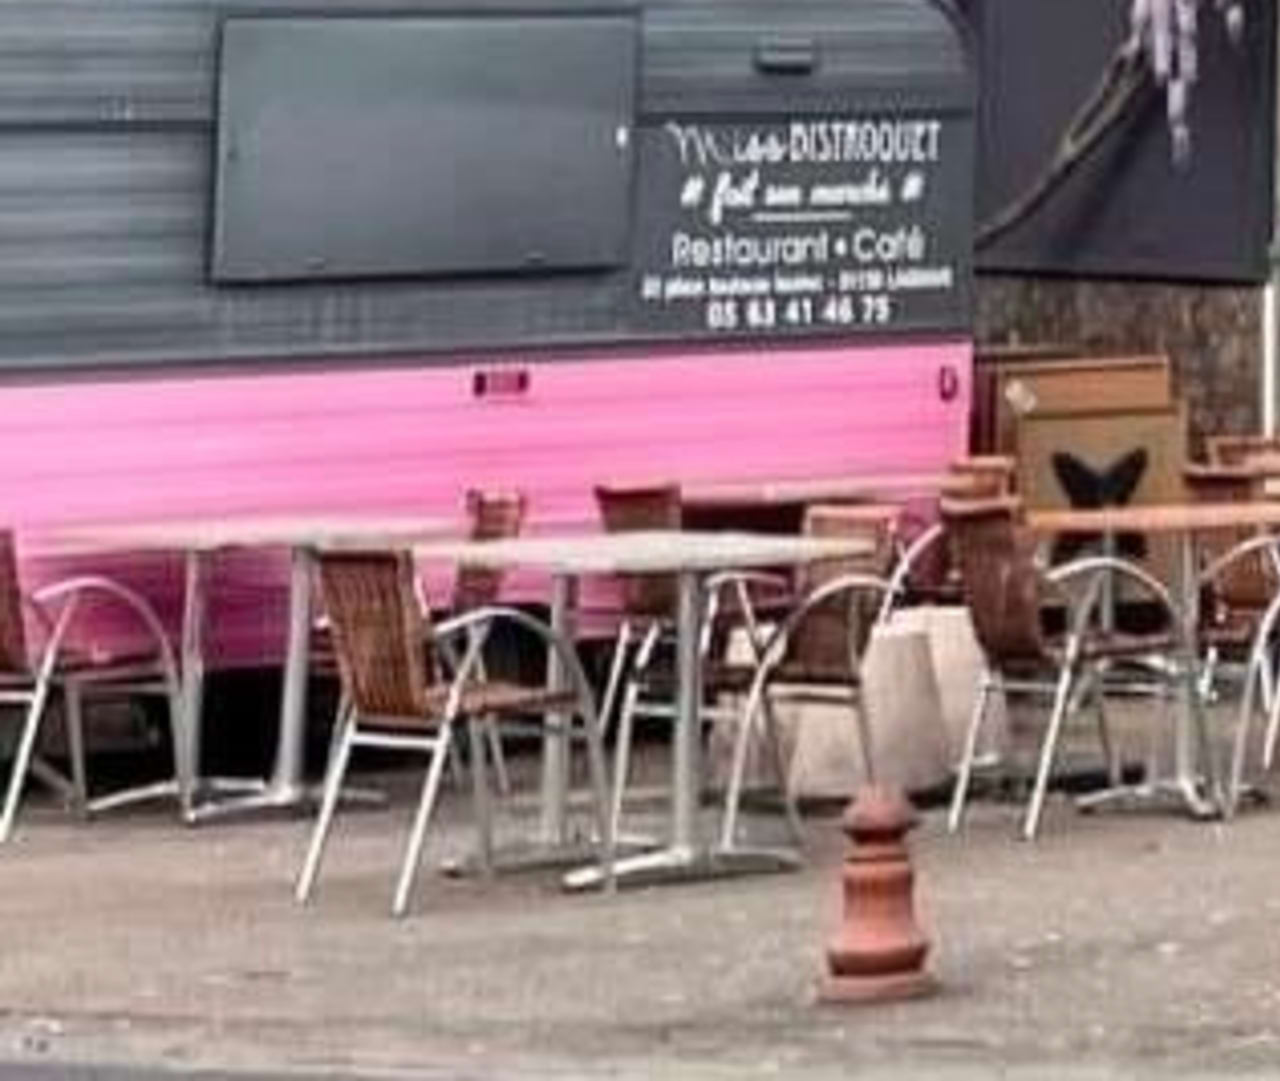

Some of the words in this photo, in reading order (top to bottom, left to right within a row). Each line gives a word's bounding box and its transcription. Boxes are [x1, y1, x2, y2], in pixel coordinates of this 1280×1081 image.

[790, 121, 942, 163] BISTROQUET
[673, 231, 829, 267] Restaurant
[853, 225, 924, 261] Café
[707, 297, 738, 328] 05
[785, 296, 812, 324] 41
